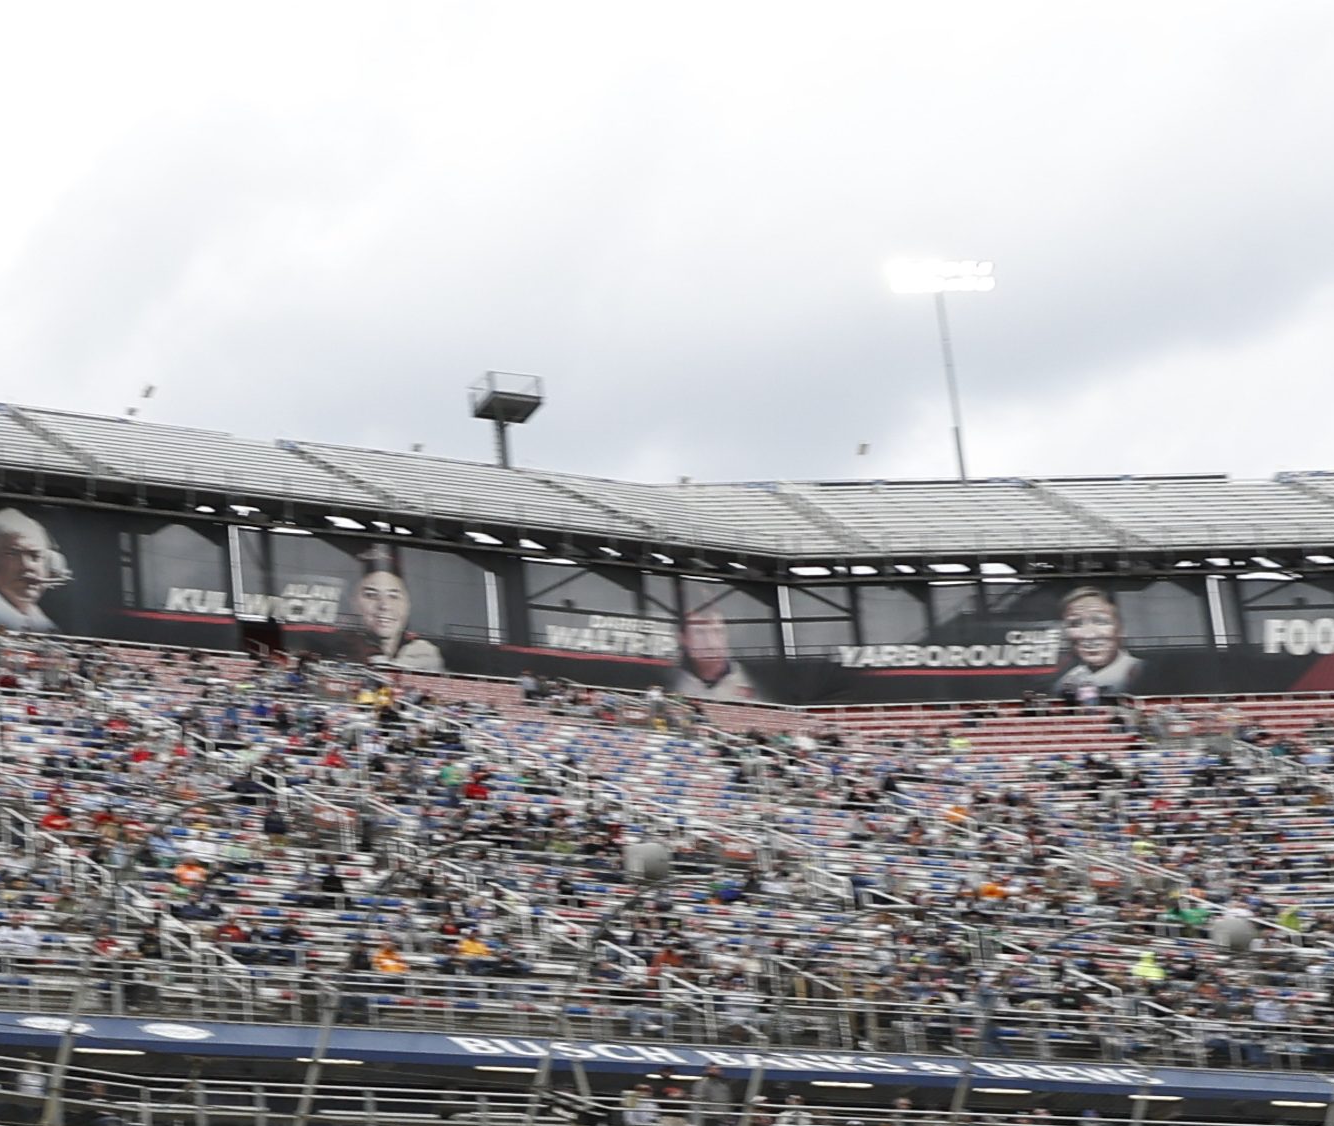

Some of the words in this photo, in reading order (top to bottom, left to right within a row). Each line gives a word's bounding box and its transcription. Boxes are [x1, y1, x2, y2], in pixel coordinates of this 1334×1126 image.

[837, 644, 1058, 668] YARBOROUGH
[446, 1036, 688, 1064] BUSCH
[970, 1061, 1166, 1086] BREWS
